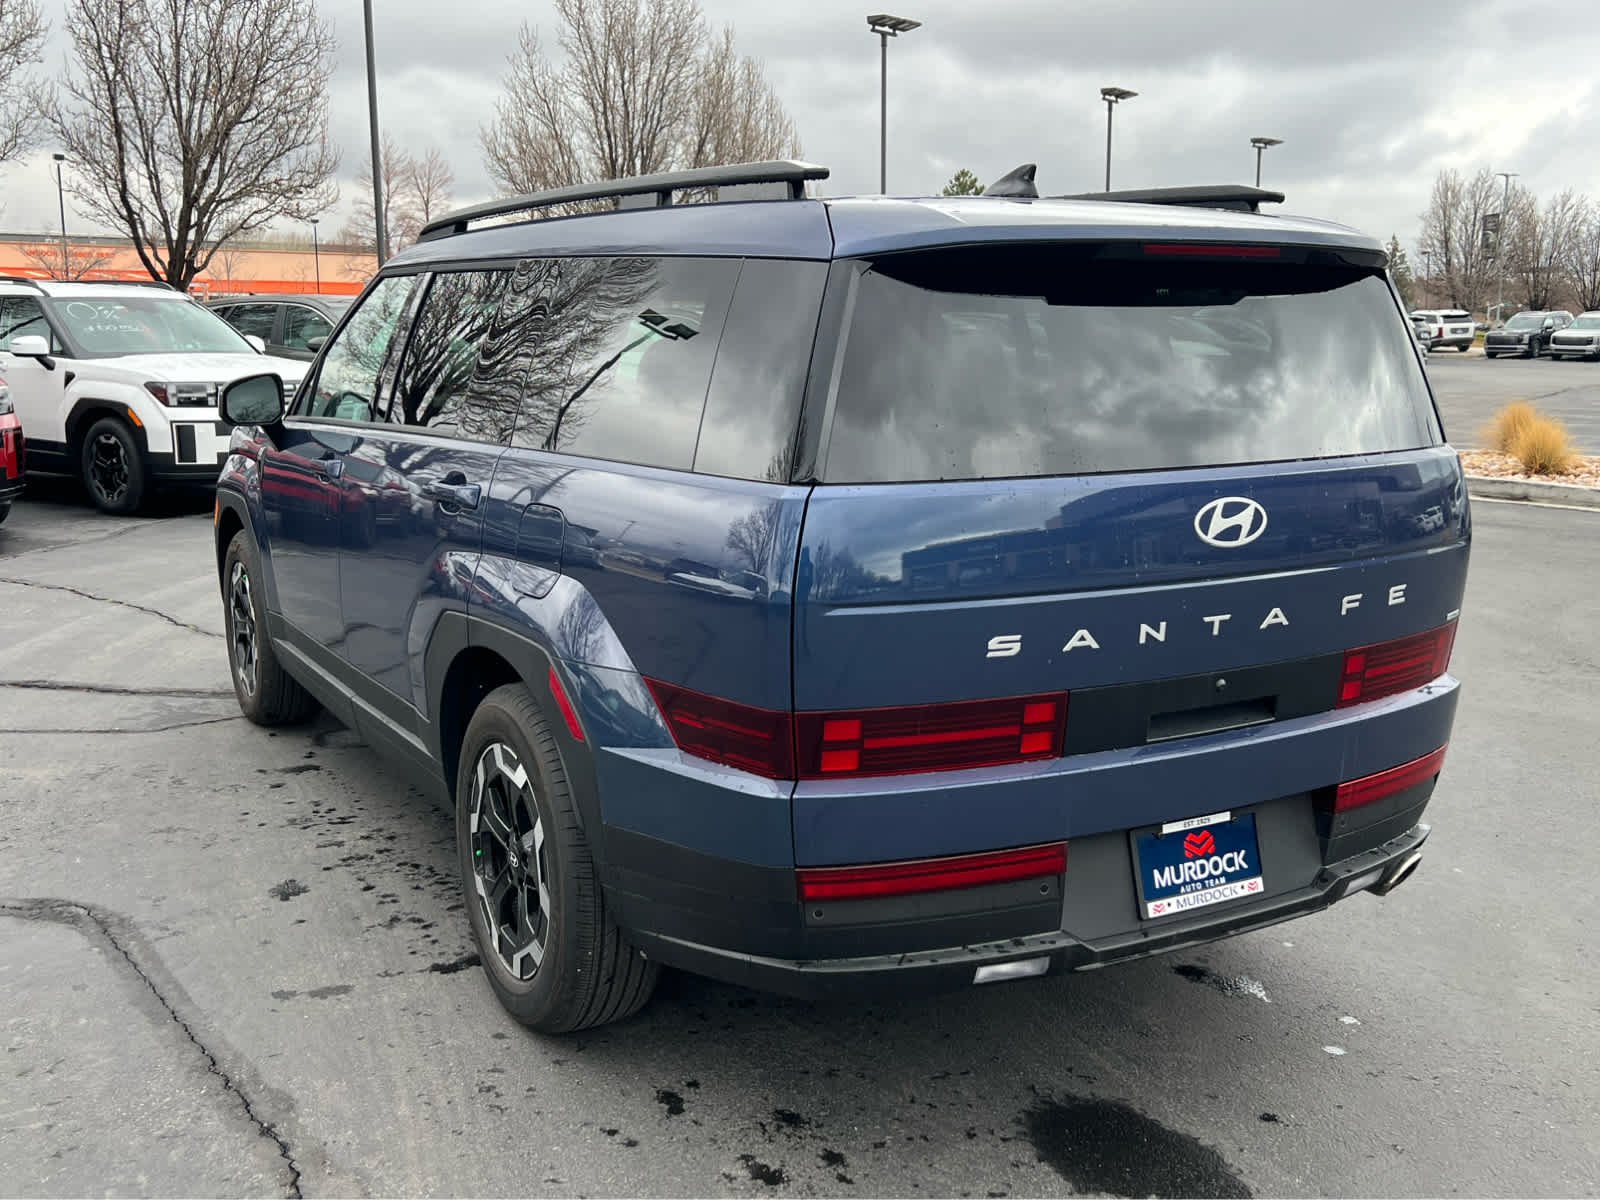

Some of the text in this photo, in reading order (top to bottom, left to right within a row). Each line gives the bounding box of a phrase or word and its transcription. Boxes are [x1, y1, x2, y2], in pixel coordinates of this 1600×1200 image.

[986, 584, 1407, 658] SANTA FE
[1153, 849, 1248, 889] MURDOCK
[1180, 876, 1226, 894] AUTO TEAM
[1176, 885, 1239, 910] MURDOCK
